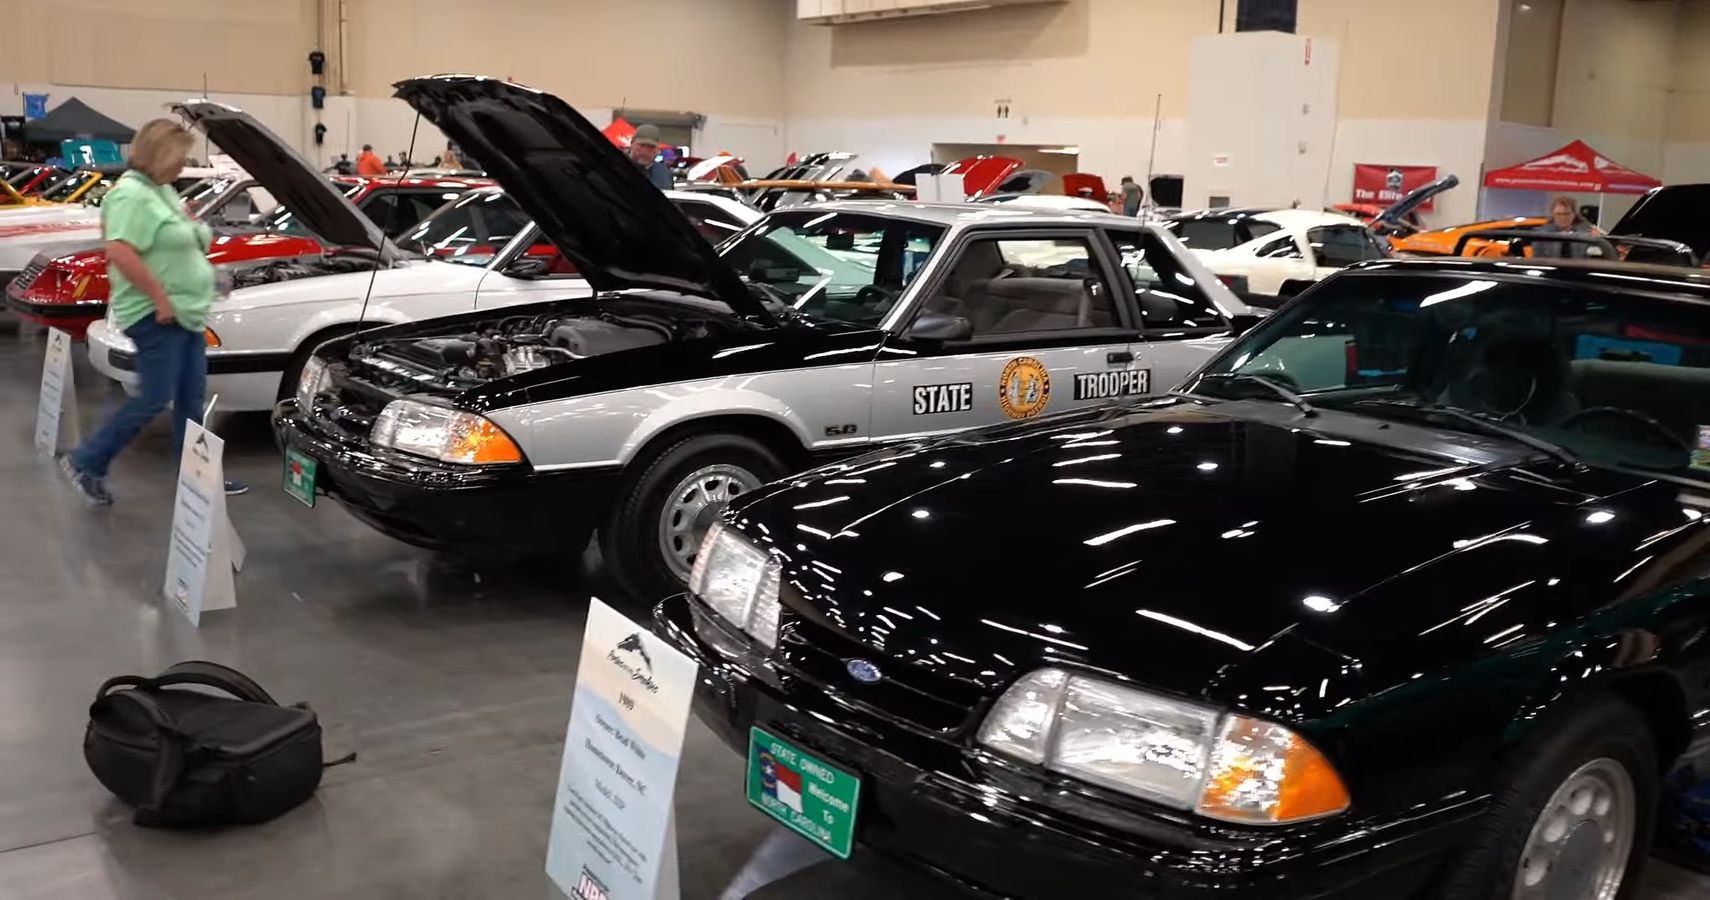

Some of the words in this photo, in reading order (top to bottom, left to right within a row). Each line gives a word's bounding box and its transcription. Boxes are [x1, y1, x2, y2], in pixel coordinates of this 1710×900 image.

[1355, 189, 1375, 199] The
[914, 383, 972, 414] STATE
[1077, 369, 1149, 400] TROOPER
[770, 742, 797, 766] STATE
[807, 781, 850, 813] Welcome
[823, 809, 835, 825] To
